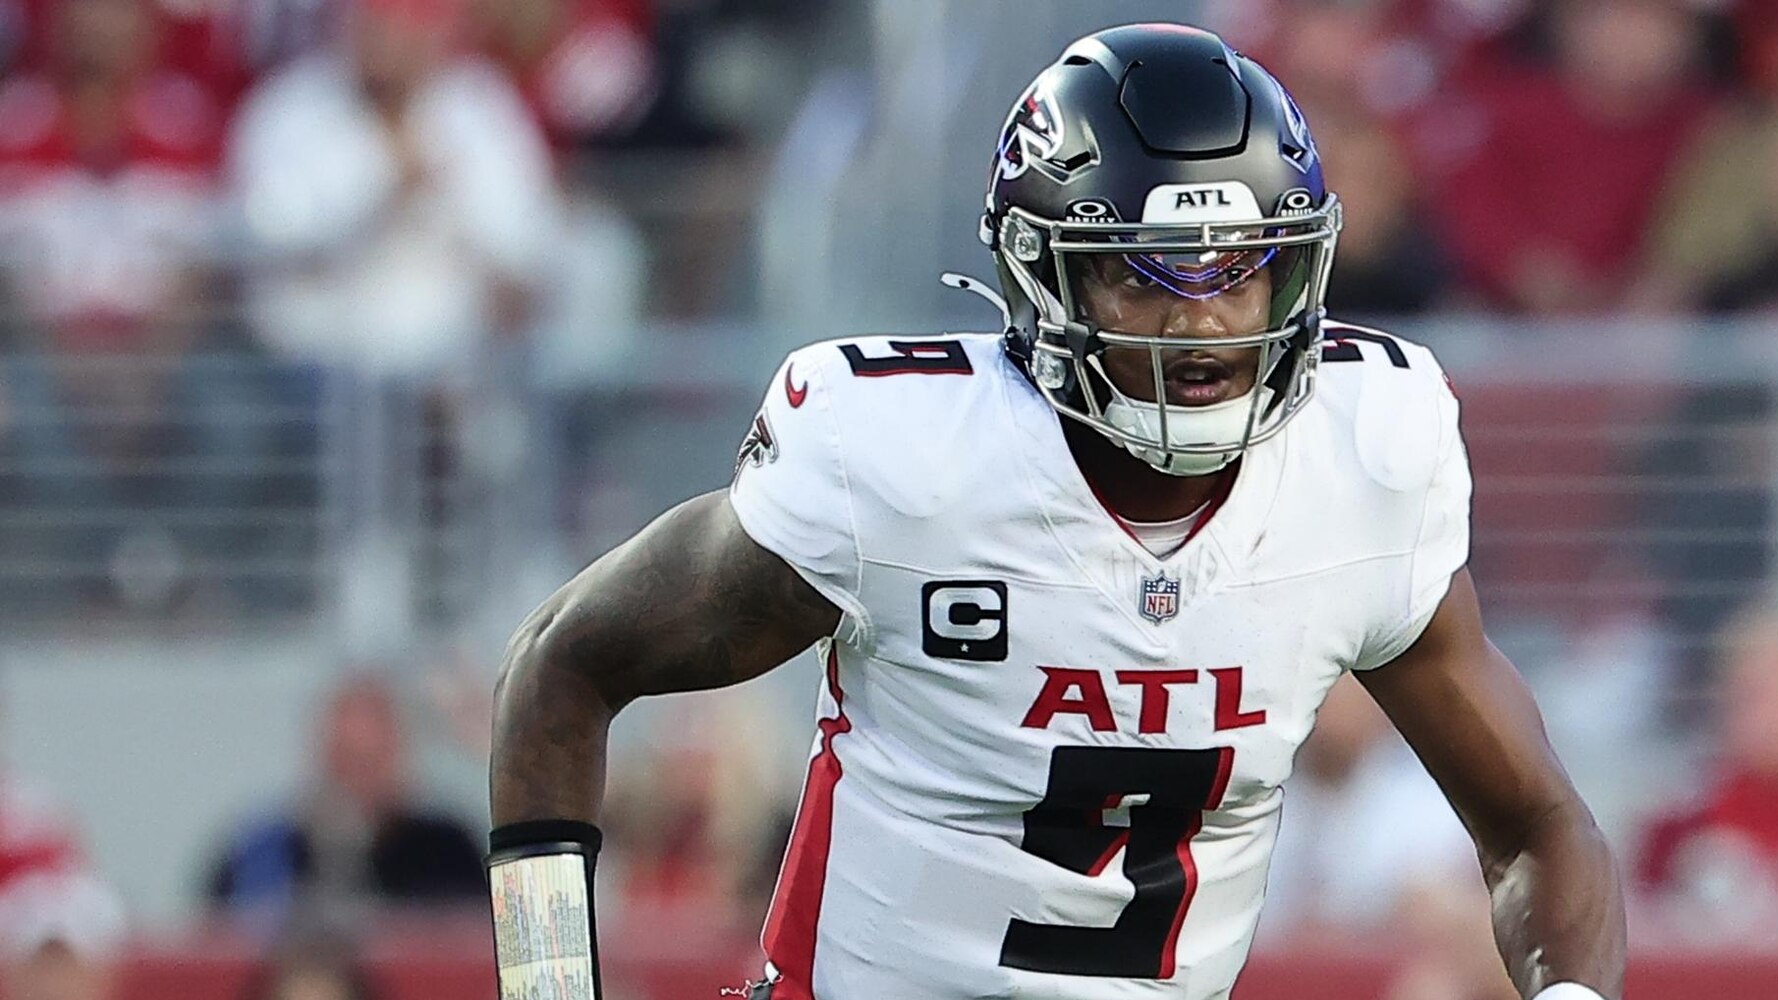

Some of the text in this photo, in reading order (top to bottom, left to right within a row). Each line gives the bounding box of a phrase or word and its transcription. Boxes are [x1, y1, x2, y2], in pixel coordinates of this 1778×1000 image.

[1175, 189, 1231, 209] ATL
[929, 587, 1001, 640] C
[1147, 595, 1174, 615] NFL
[1020, 666, 1266, 734] ATL
[999, 745, 1236, 980] 9
